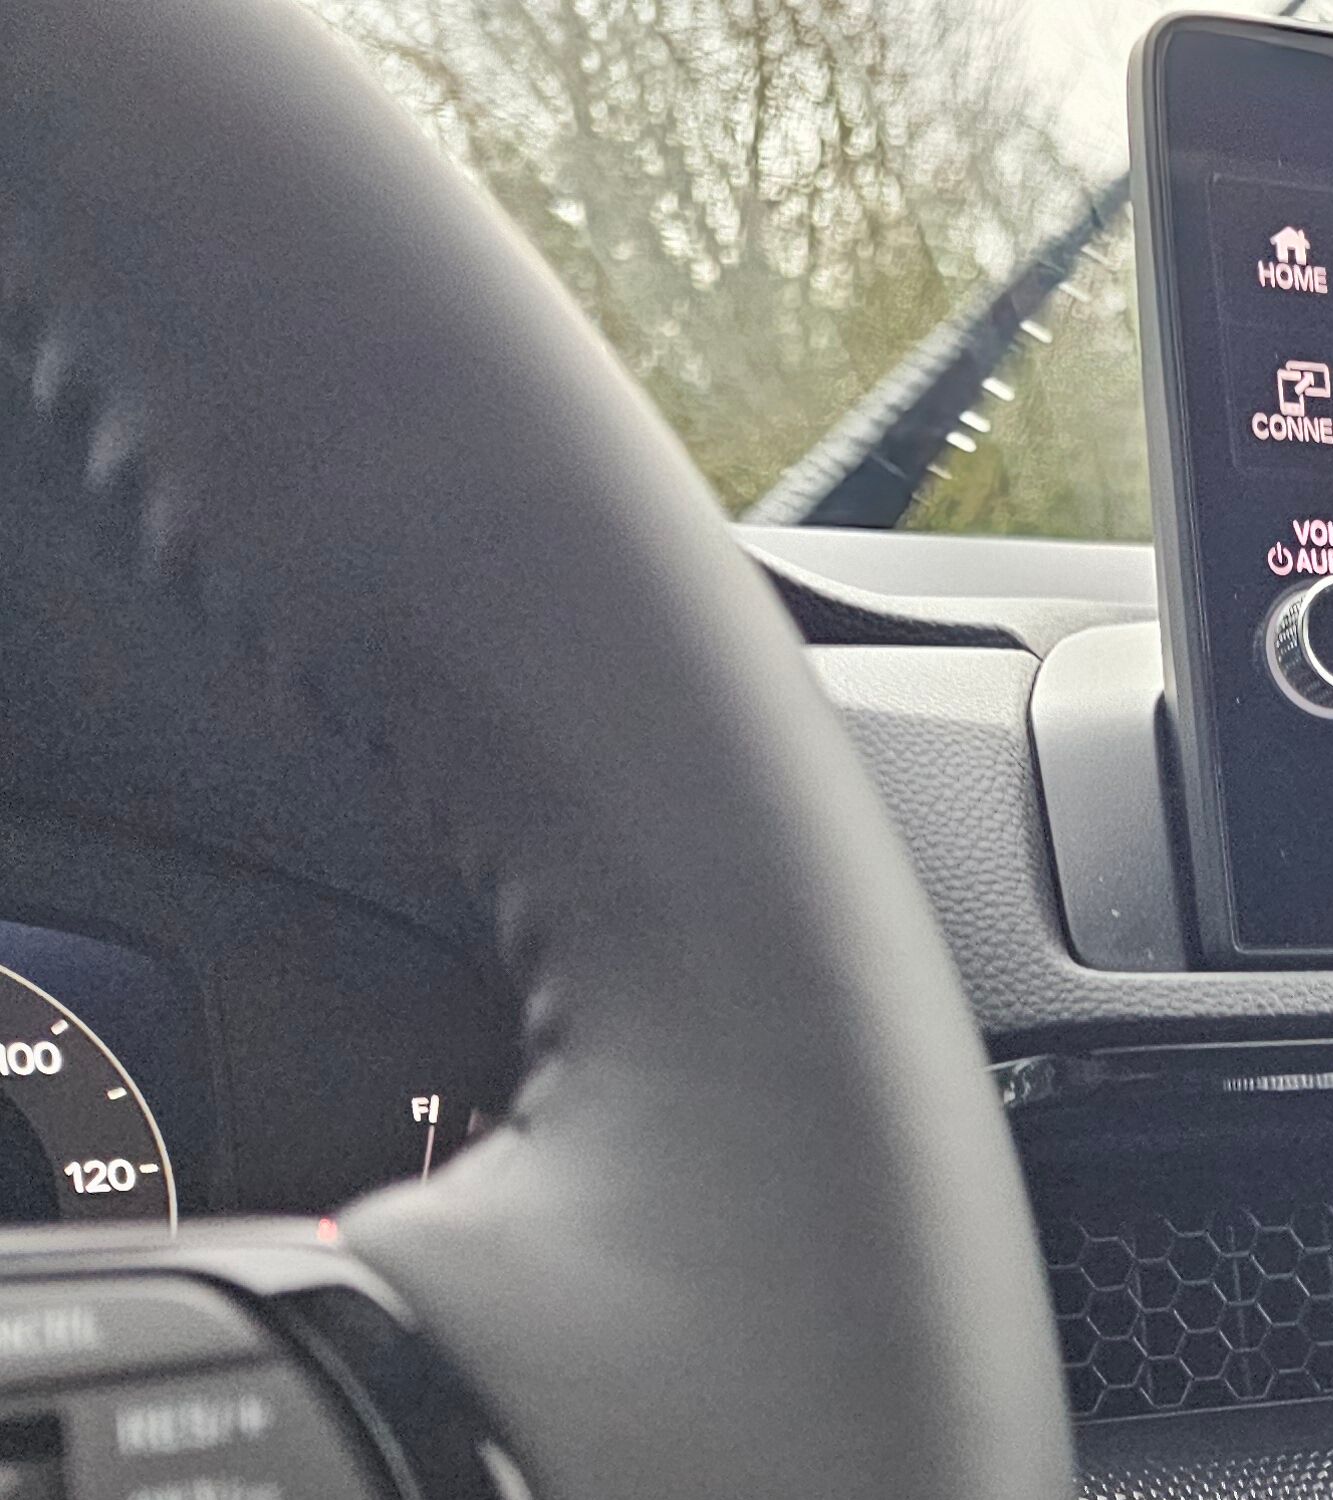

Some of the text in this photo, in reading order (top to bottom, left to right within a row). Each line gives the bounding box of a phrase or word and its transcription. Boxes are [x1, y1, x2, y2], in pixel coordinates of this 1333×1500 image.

[1257, 261, 1328, 294] HOME
[0, 1041, 63, 1076] 100
[63, 1158, 137, 1194] 120
